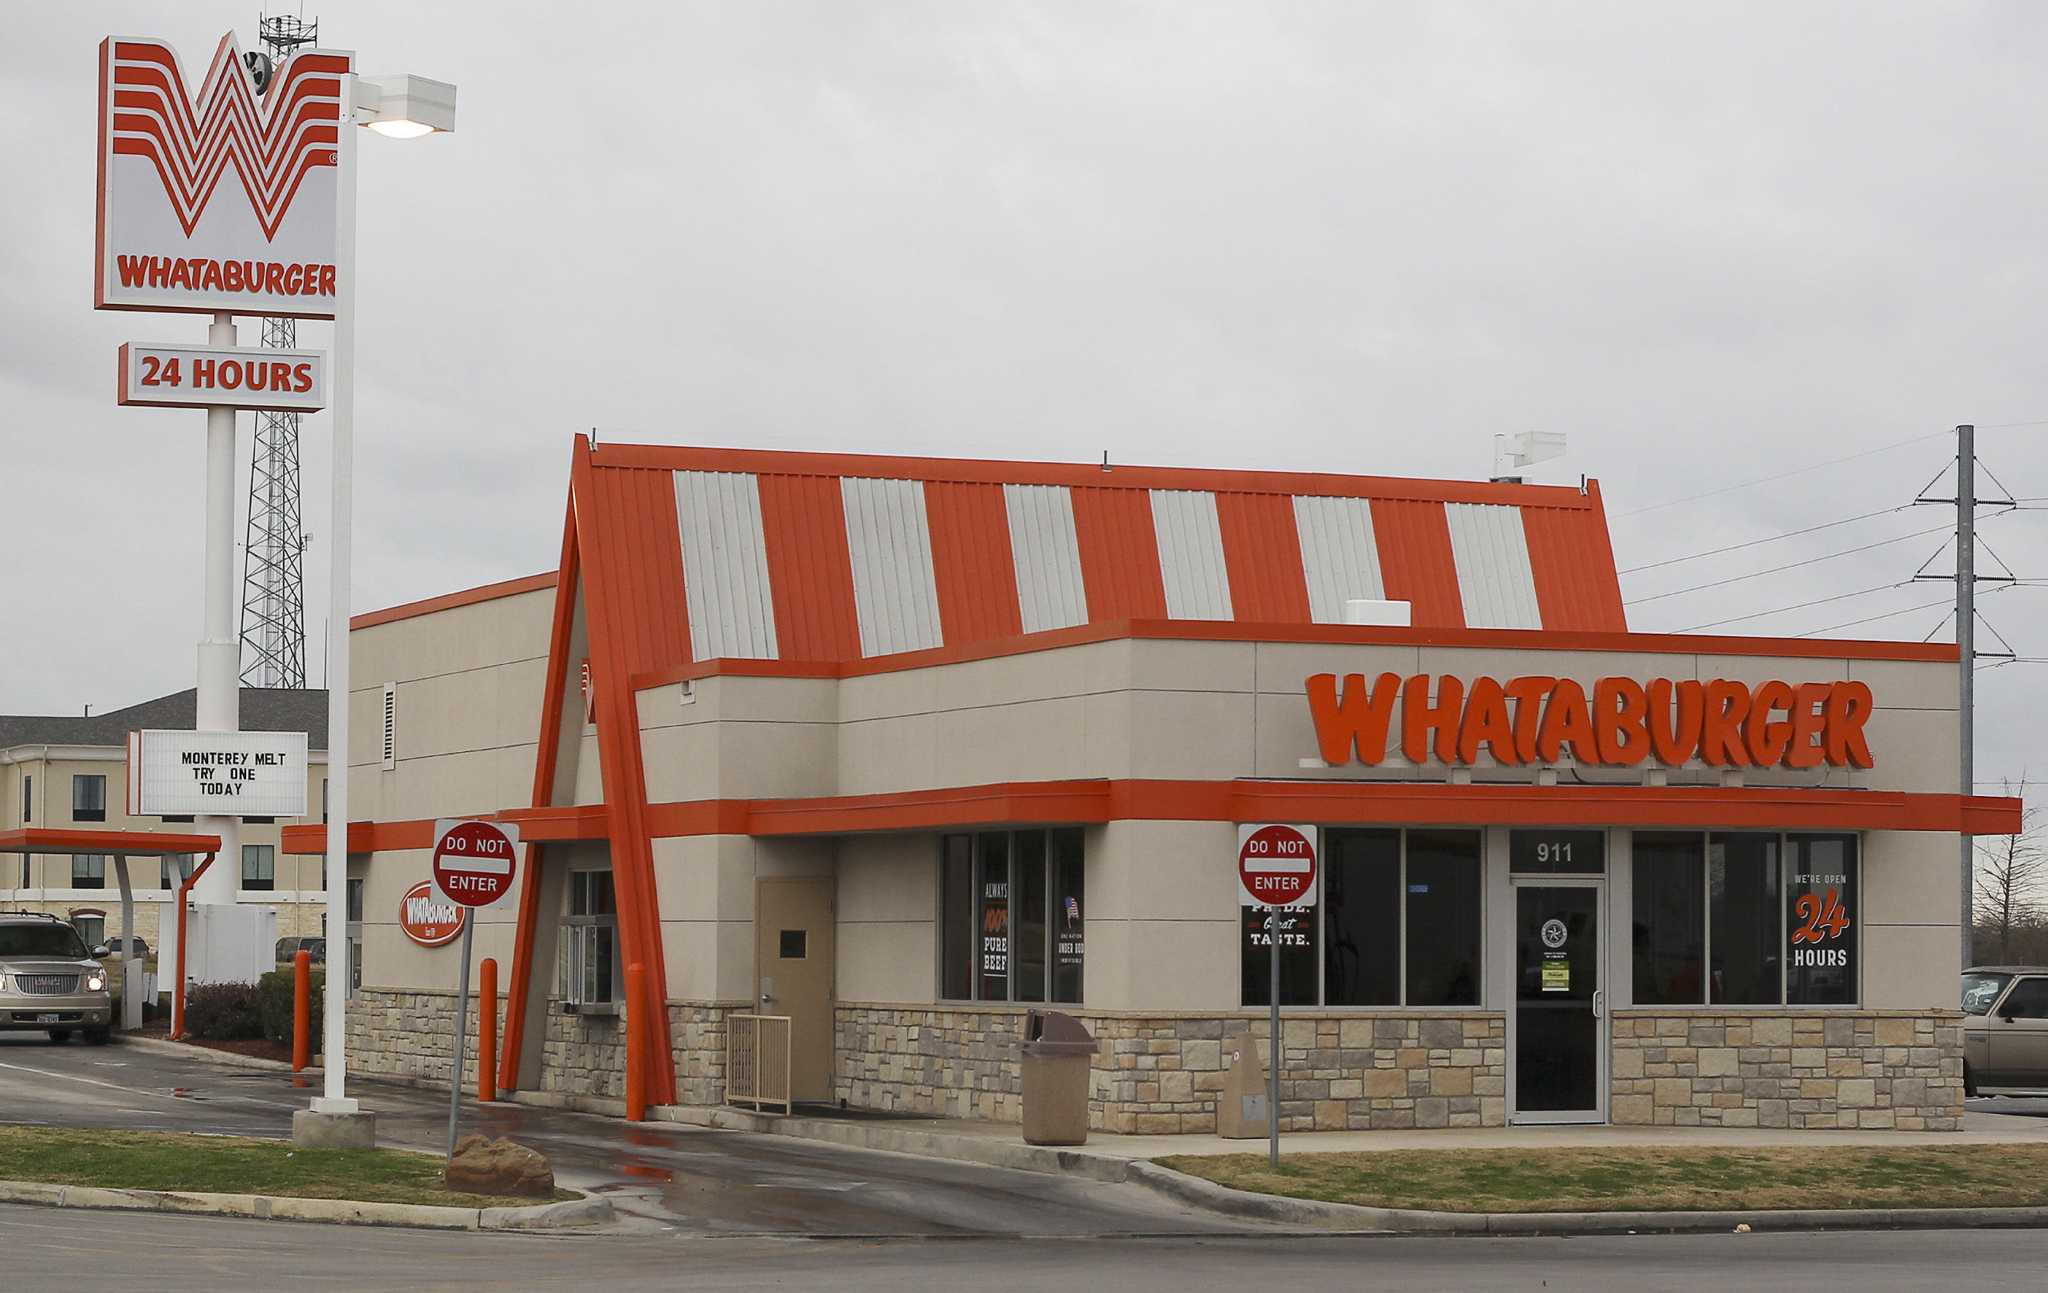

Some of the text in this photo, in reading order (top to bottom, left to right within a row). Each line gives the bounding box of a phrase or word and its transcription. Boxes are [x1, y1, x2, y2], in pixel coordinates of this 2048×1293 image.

[117, 254, 336, 297] WHATABURGER
[141, 356, 312, 393] 24 HOURS
[1305, 672, 1873, 769] WHATABURGER
[182, 752, 286, 766] MONTEREY MELT
[193, 767, 256, 781] TRY ONE
[200, 782, 242, 796] TODAY
[446, 836, 506, 854] DO NOT
[1250, 840, 1305, 854] DO NOT
[1537, 842, 1572, 862] 911
[449, 875, 498, 892] ENTER
[1255, 877, 1300, 890] ENTER
[1824, 874, 1847, 884] OPEN
[985, 883, 1008, 898] ALWAYS
[1791, 886, 1850, 944] 24
[984, 937, 1007, 952] PURE
[984, 955, 1007, 970] BEEF
[1794, 949, 1847, 966] HOURS
